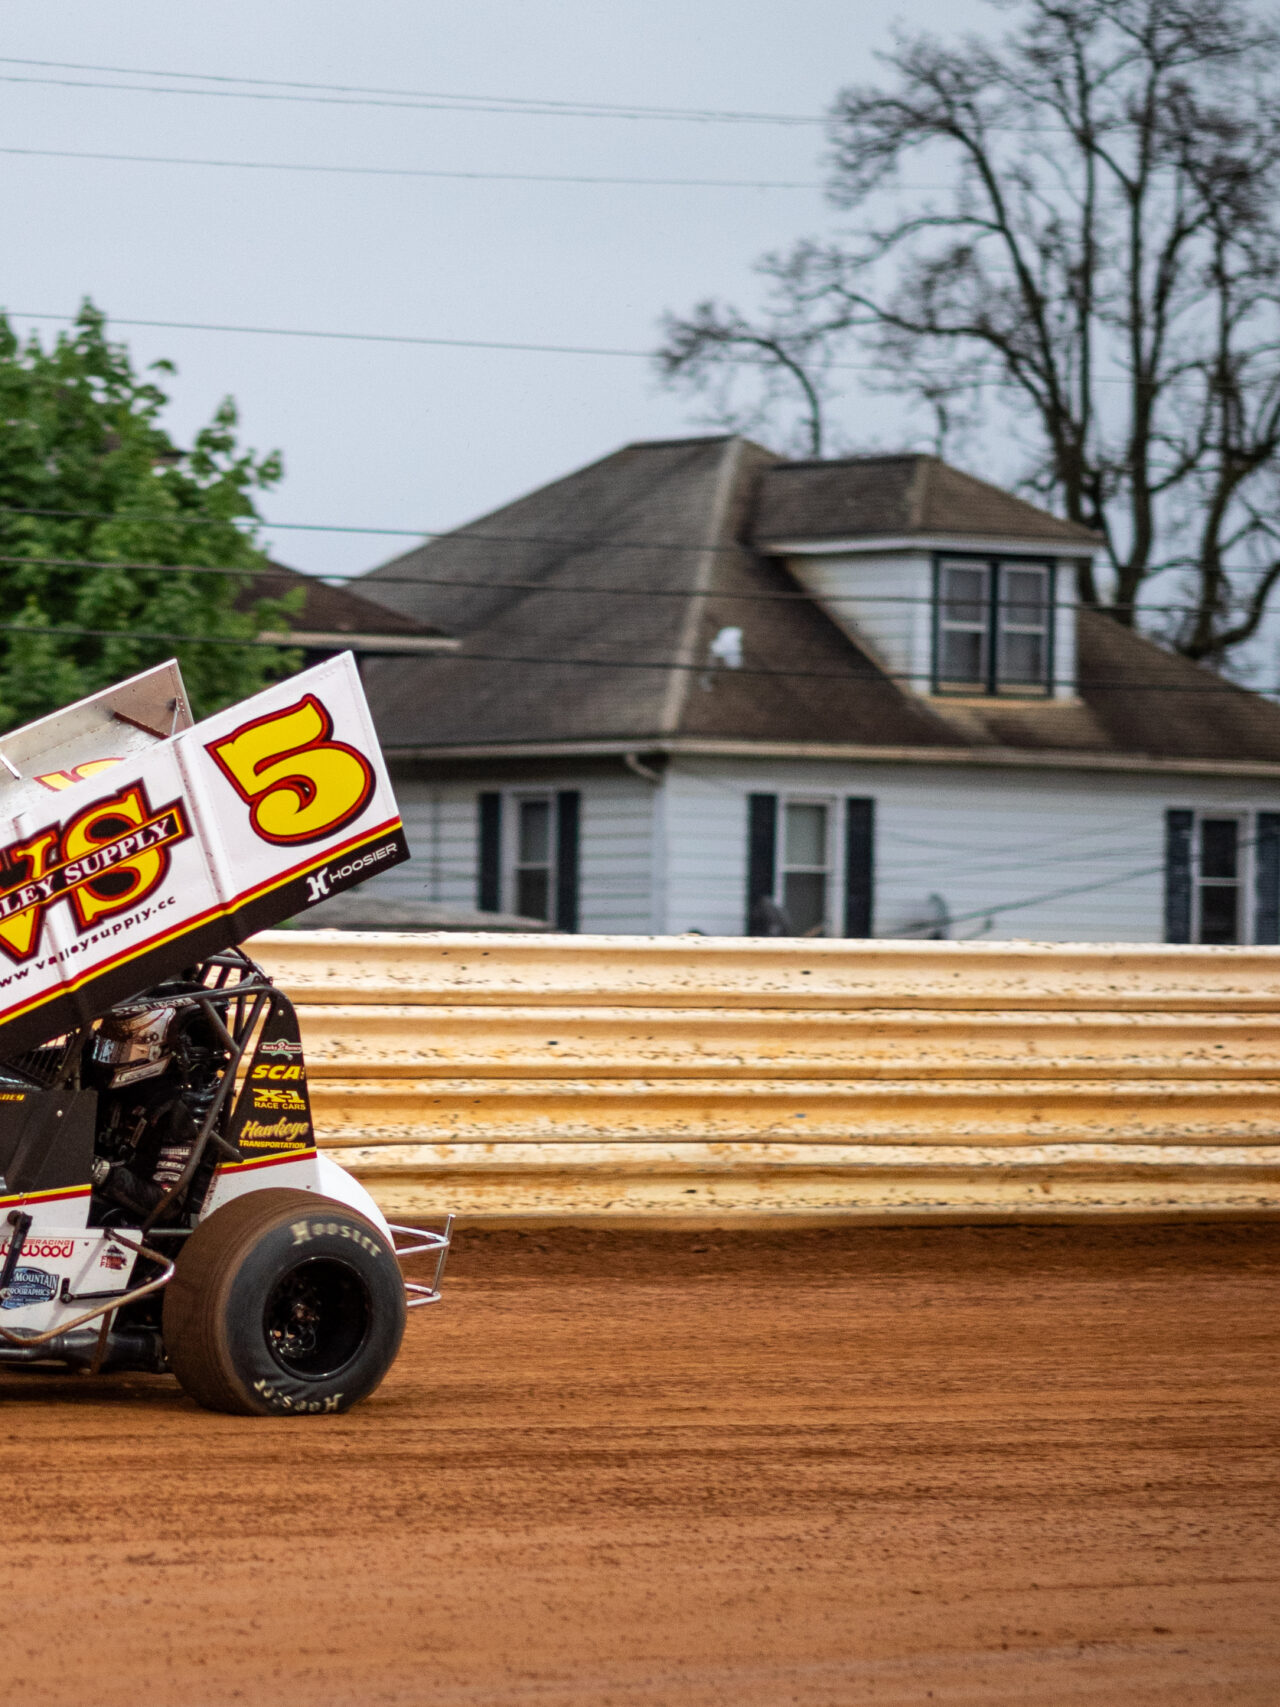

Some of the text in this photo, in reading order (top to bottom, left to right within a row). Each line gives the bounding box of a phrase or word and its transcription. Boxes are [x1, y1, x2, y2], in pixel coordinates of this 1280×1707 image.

[204, 693, 376, 847] 5
[65, 818, 169, 886] SUPPLY
[329, 843, 398, 884] HOOSIER
[254, 1102, 306, 1111] RACE CARS
[239, 1139, 307, 1149] TRANSPORTATION
